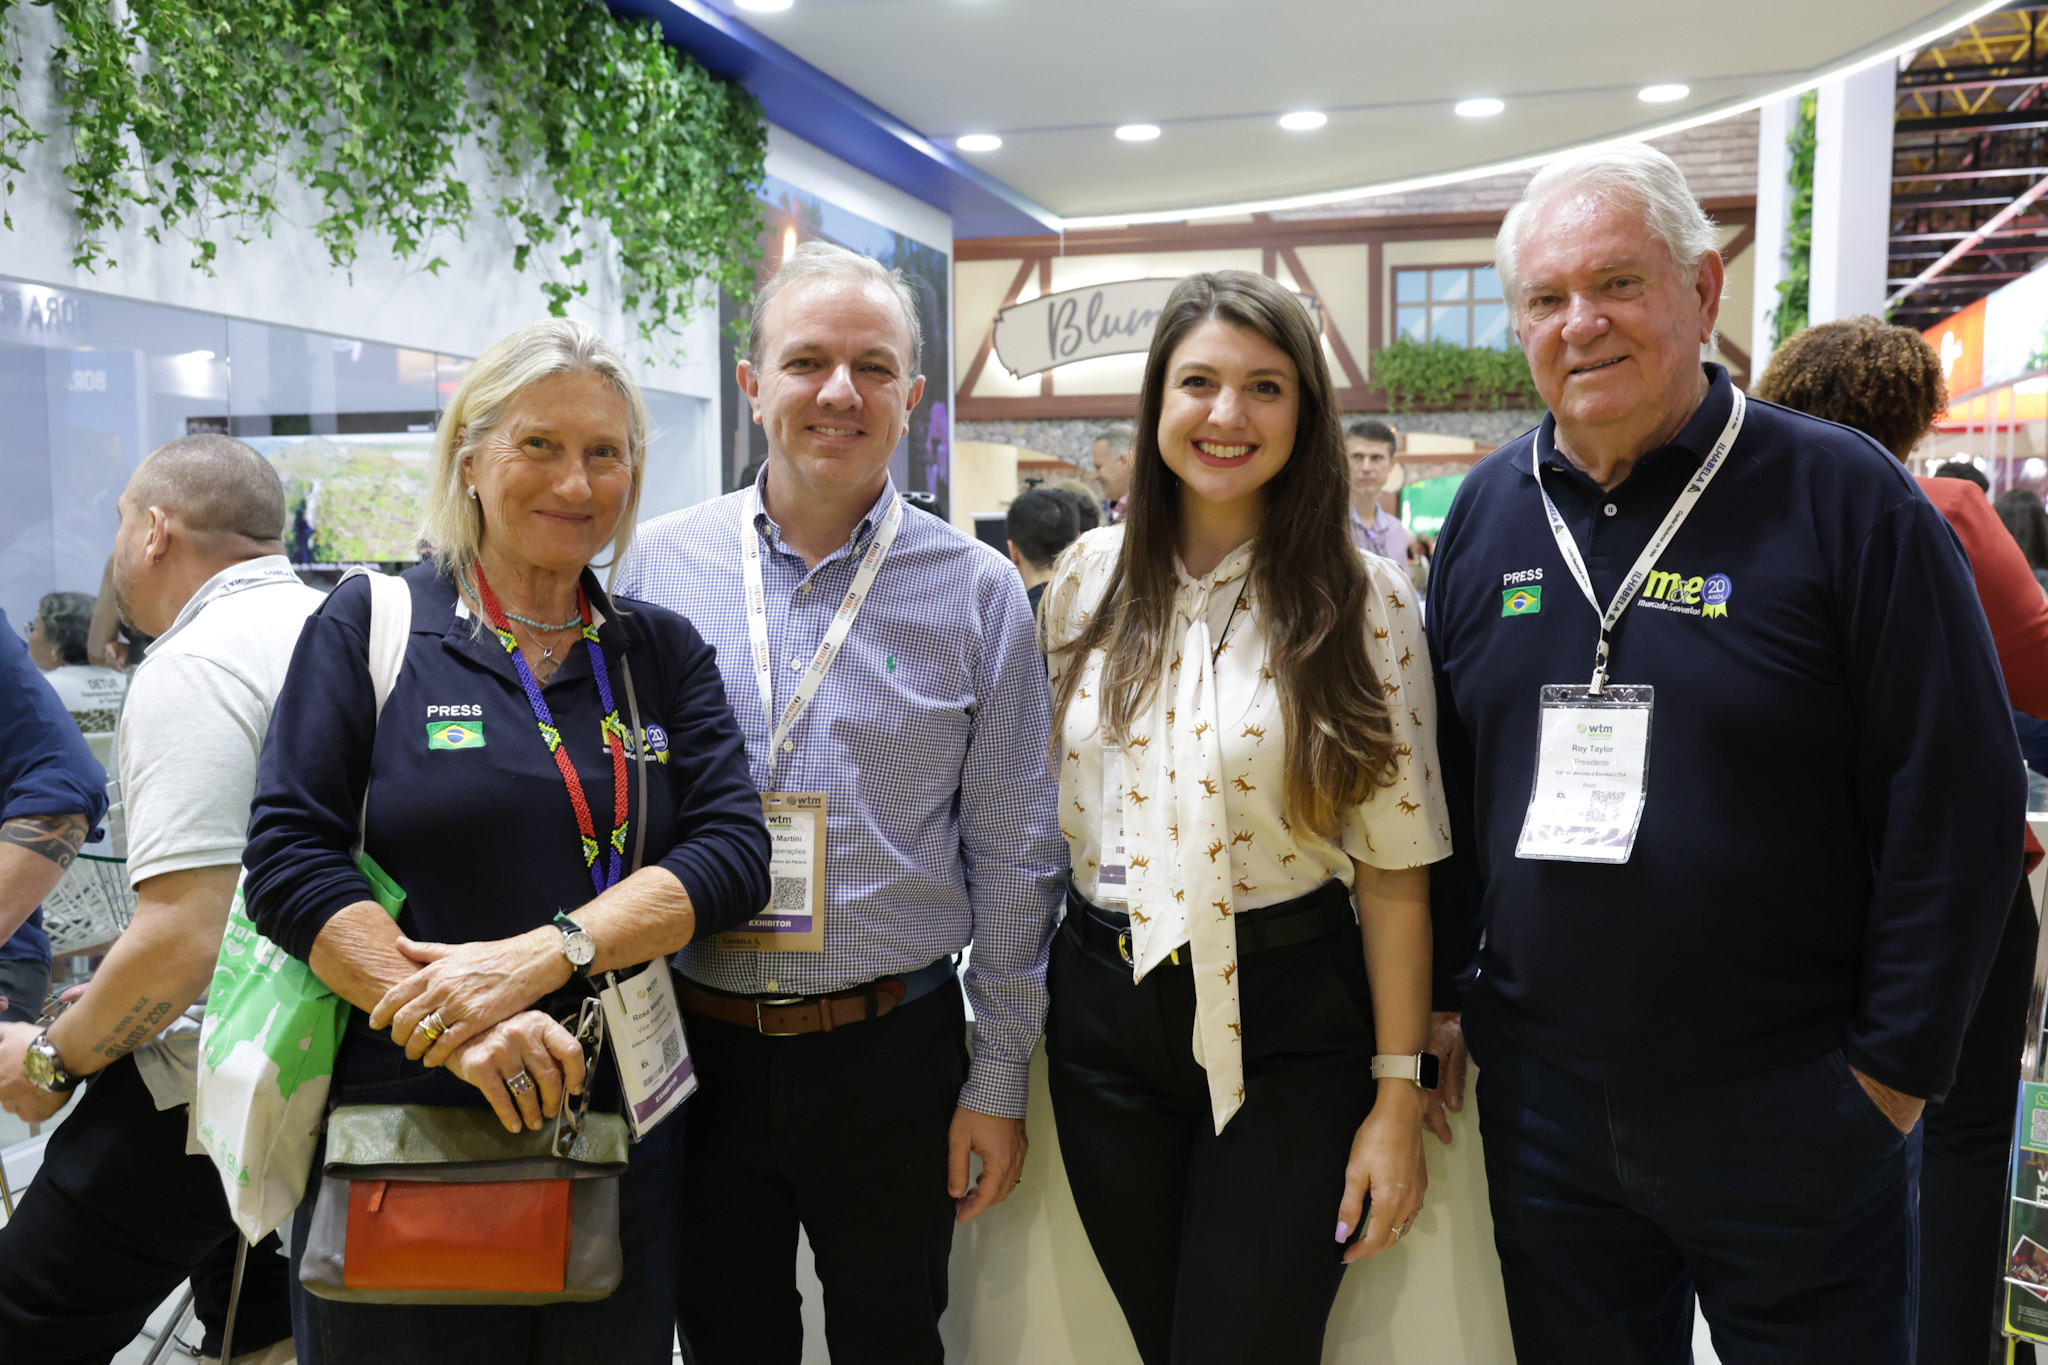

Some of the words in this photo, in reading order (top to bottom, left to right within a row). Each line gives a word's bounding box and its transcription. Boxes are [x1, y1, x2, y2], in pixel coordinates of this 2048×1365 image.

[1049, 291, 1160, 360] Blum
[1696, 442, 1726, 482] ILHABELA
[1670, 510, 1683, 525] Capital
[1660, 524, 1674, 543] Nacional
[863, 542, 880, 569] oman
[1503, 567, 1543, 586] PRESS
[1612, 570, 1642, 612] ILHABELA
[1708, 580, 1725, 594] 20
[754, 584, 763, 614] oman
[838, 592, 857, 620] oman
[759, 640, 768, 672] oman
[812, 642, 831, 671] oman
[820, 645, 836, 675] experience
[427, 704, 482, 718] PRESS
[649, 729, 664, 741] 20
[1589, 724, 1612, 733] wtm
[1572, 744, 1588, 754] Roy
[1590, 745, 1614, 754] Taylor
[1574, 758, 1610, 766] Presidente
[798, 796, 821, 804] wtm
[769, 815, 792, 824] wtm
[772, 848, 806, 856] operações
[748, 920, 792, 928] EXHIBITOR
[633, 1009, 650, 1022] Rosa
[637, 1024, 650, 1034] Vice
